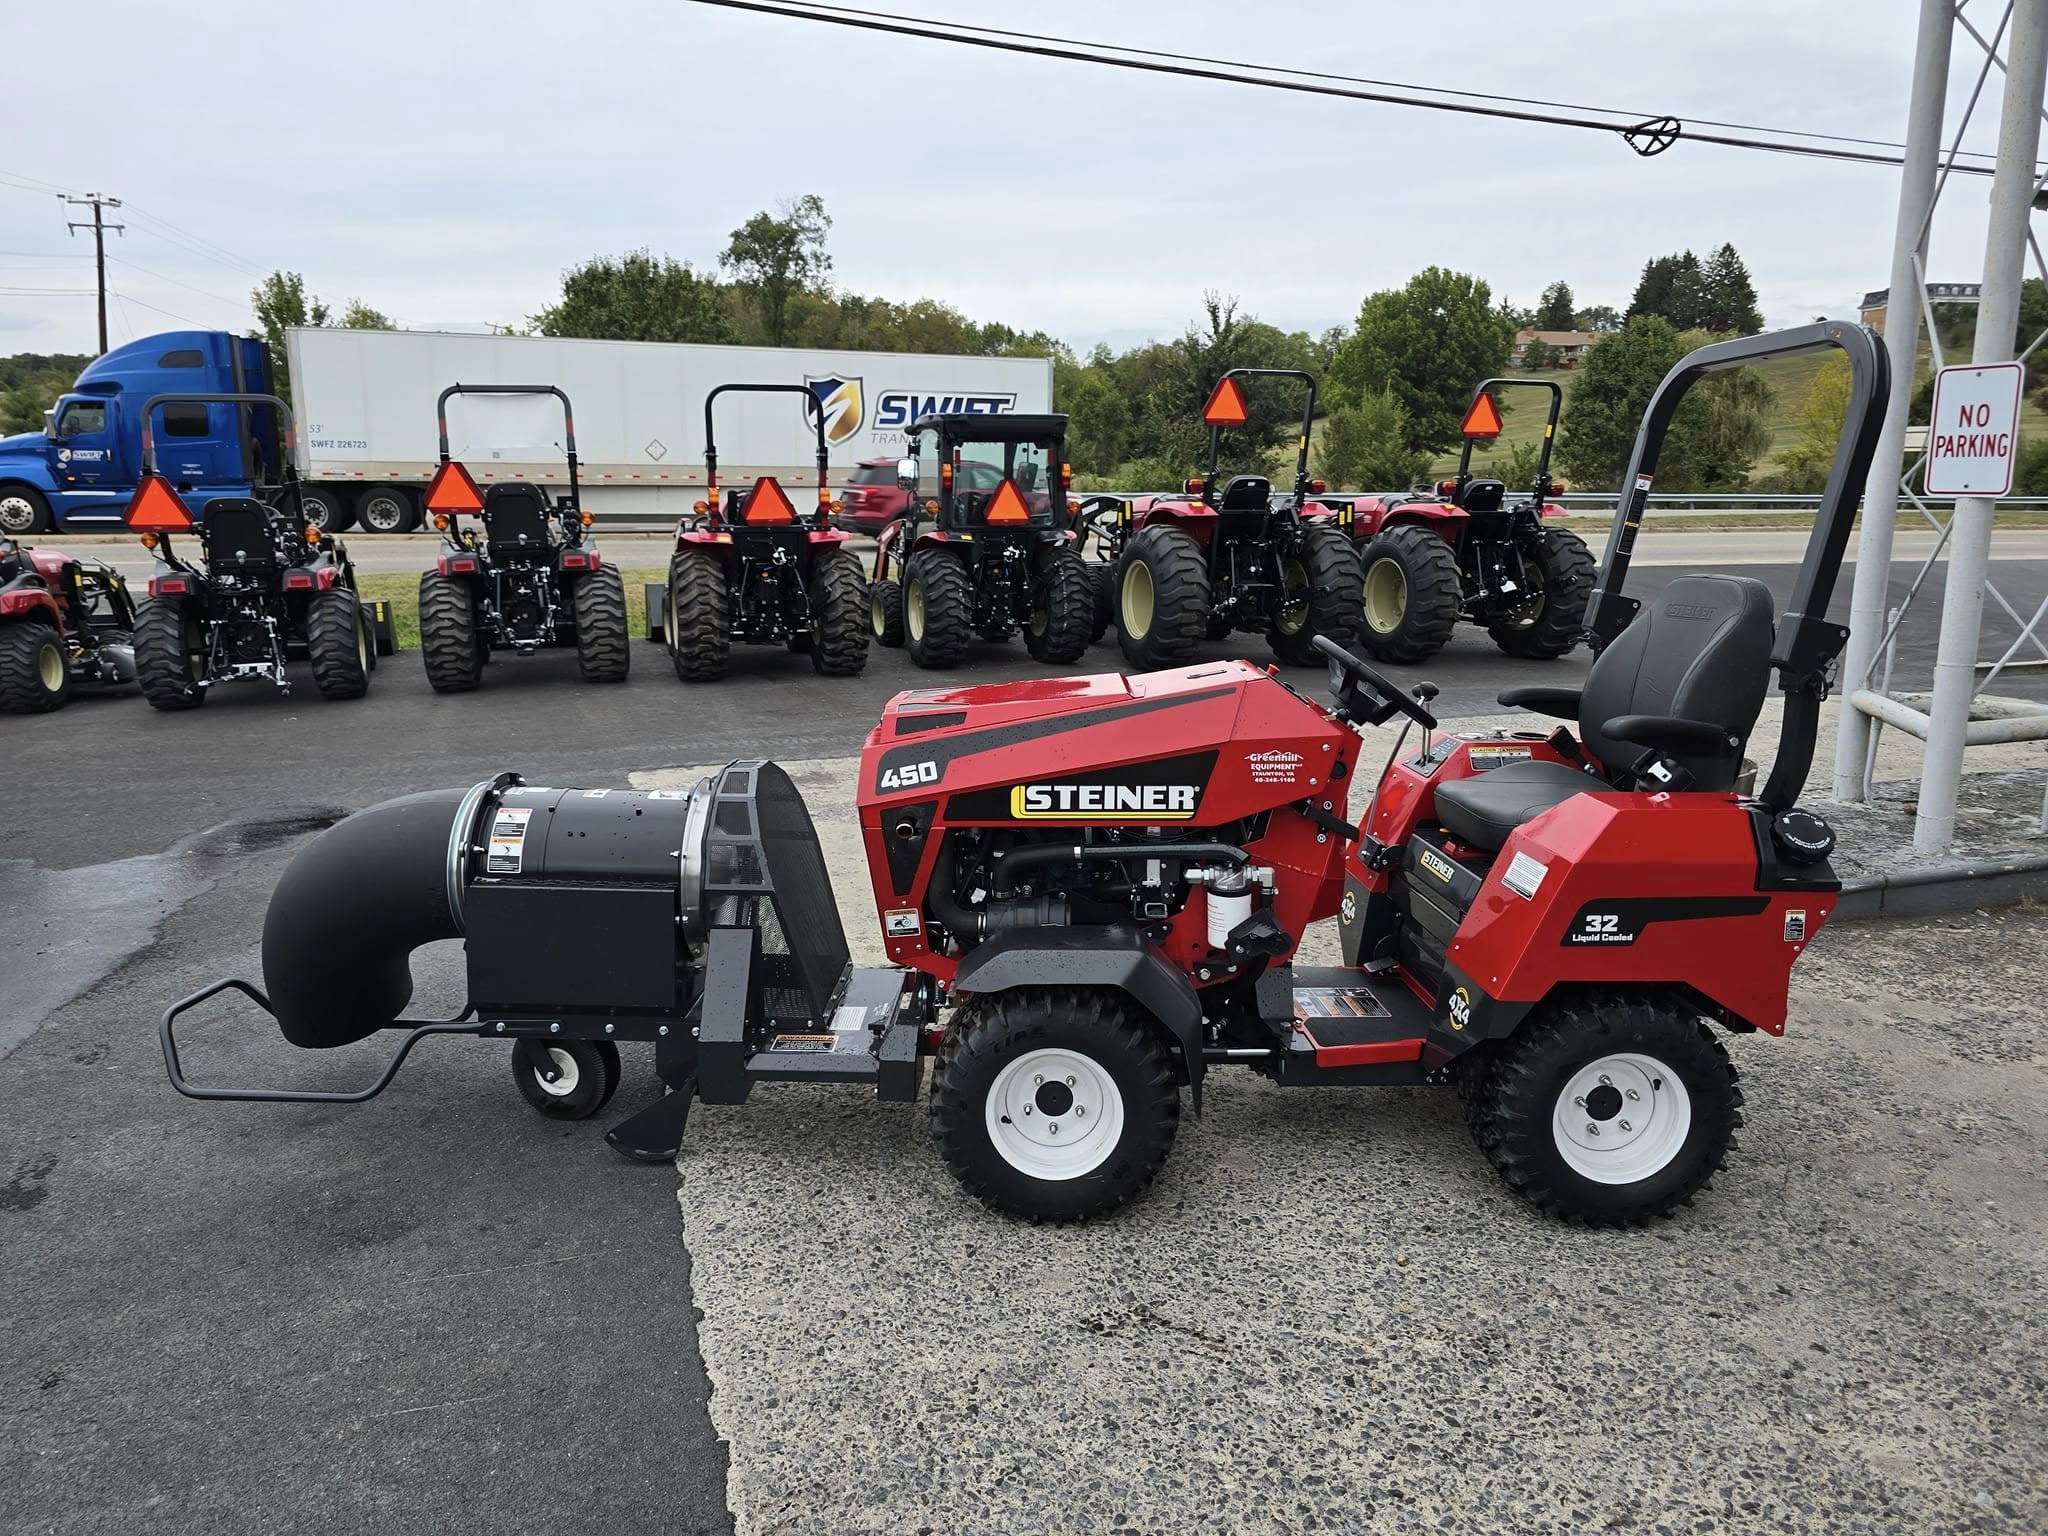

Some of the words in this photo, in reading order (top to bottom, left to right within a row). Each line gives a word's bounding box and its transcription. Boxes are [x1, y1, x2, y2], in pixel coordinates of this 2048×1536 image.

[878, 395, 1011, 424] SWIFT
[1958, 403, 1990, 428] NO
[310, 439, 335, 448] SWFZ
[337, 440, 368, 449] 226723
[1935, 433, 2008, 458] PARKING
[1250, 753, 1298, 761] Greenhill
[1251, 763, 1296, 771] EQUIPMENT
[881, 761, 938, 788] 450
[1026, 785, 1194, 810] STEINER
[1424, 852, 1455, 880] STEINER
[1585, 914, 1619, 932] 32
[1572, 934, 1600, 943] Liquid
[1601, 933, 1633, 941] Cooled
